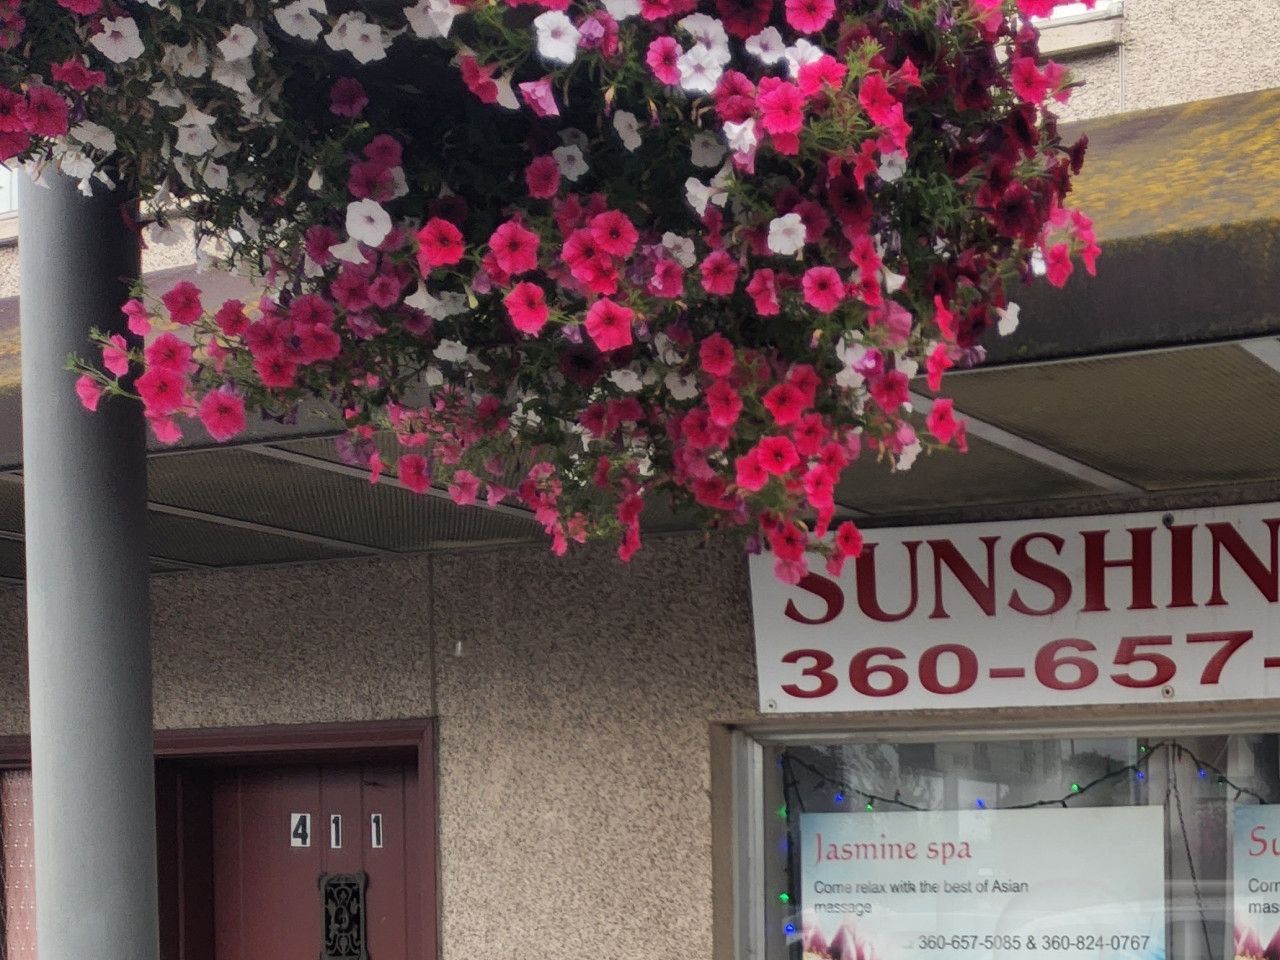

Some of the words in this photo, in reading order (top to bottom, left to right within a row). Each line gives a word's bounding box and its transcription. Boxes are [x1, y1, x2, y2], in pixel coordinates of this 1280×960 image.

[814, 834, 917, 865] Jasmine
[927, 840, 973, 866] spa
[814, 880, 852, 894] Come
[855, 880, 887, 894] relax
[889, 880, 916, 894] with
[919, 880, 938, 894] the
[943, 880, 972, 894] best
[974, 879, 989, 893] of
[992, 879, 1029, 893] Asian
[814, 900, 872, 916] massage
[918, 934, 1021, 951] 360-657-5085
[1026, 935, 1037, 950] &
[1042, 934, 1150, 951] 360-824-0767
